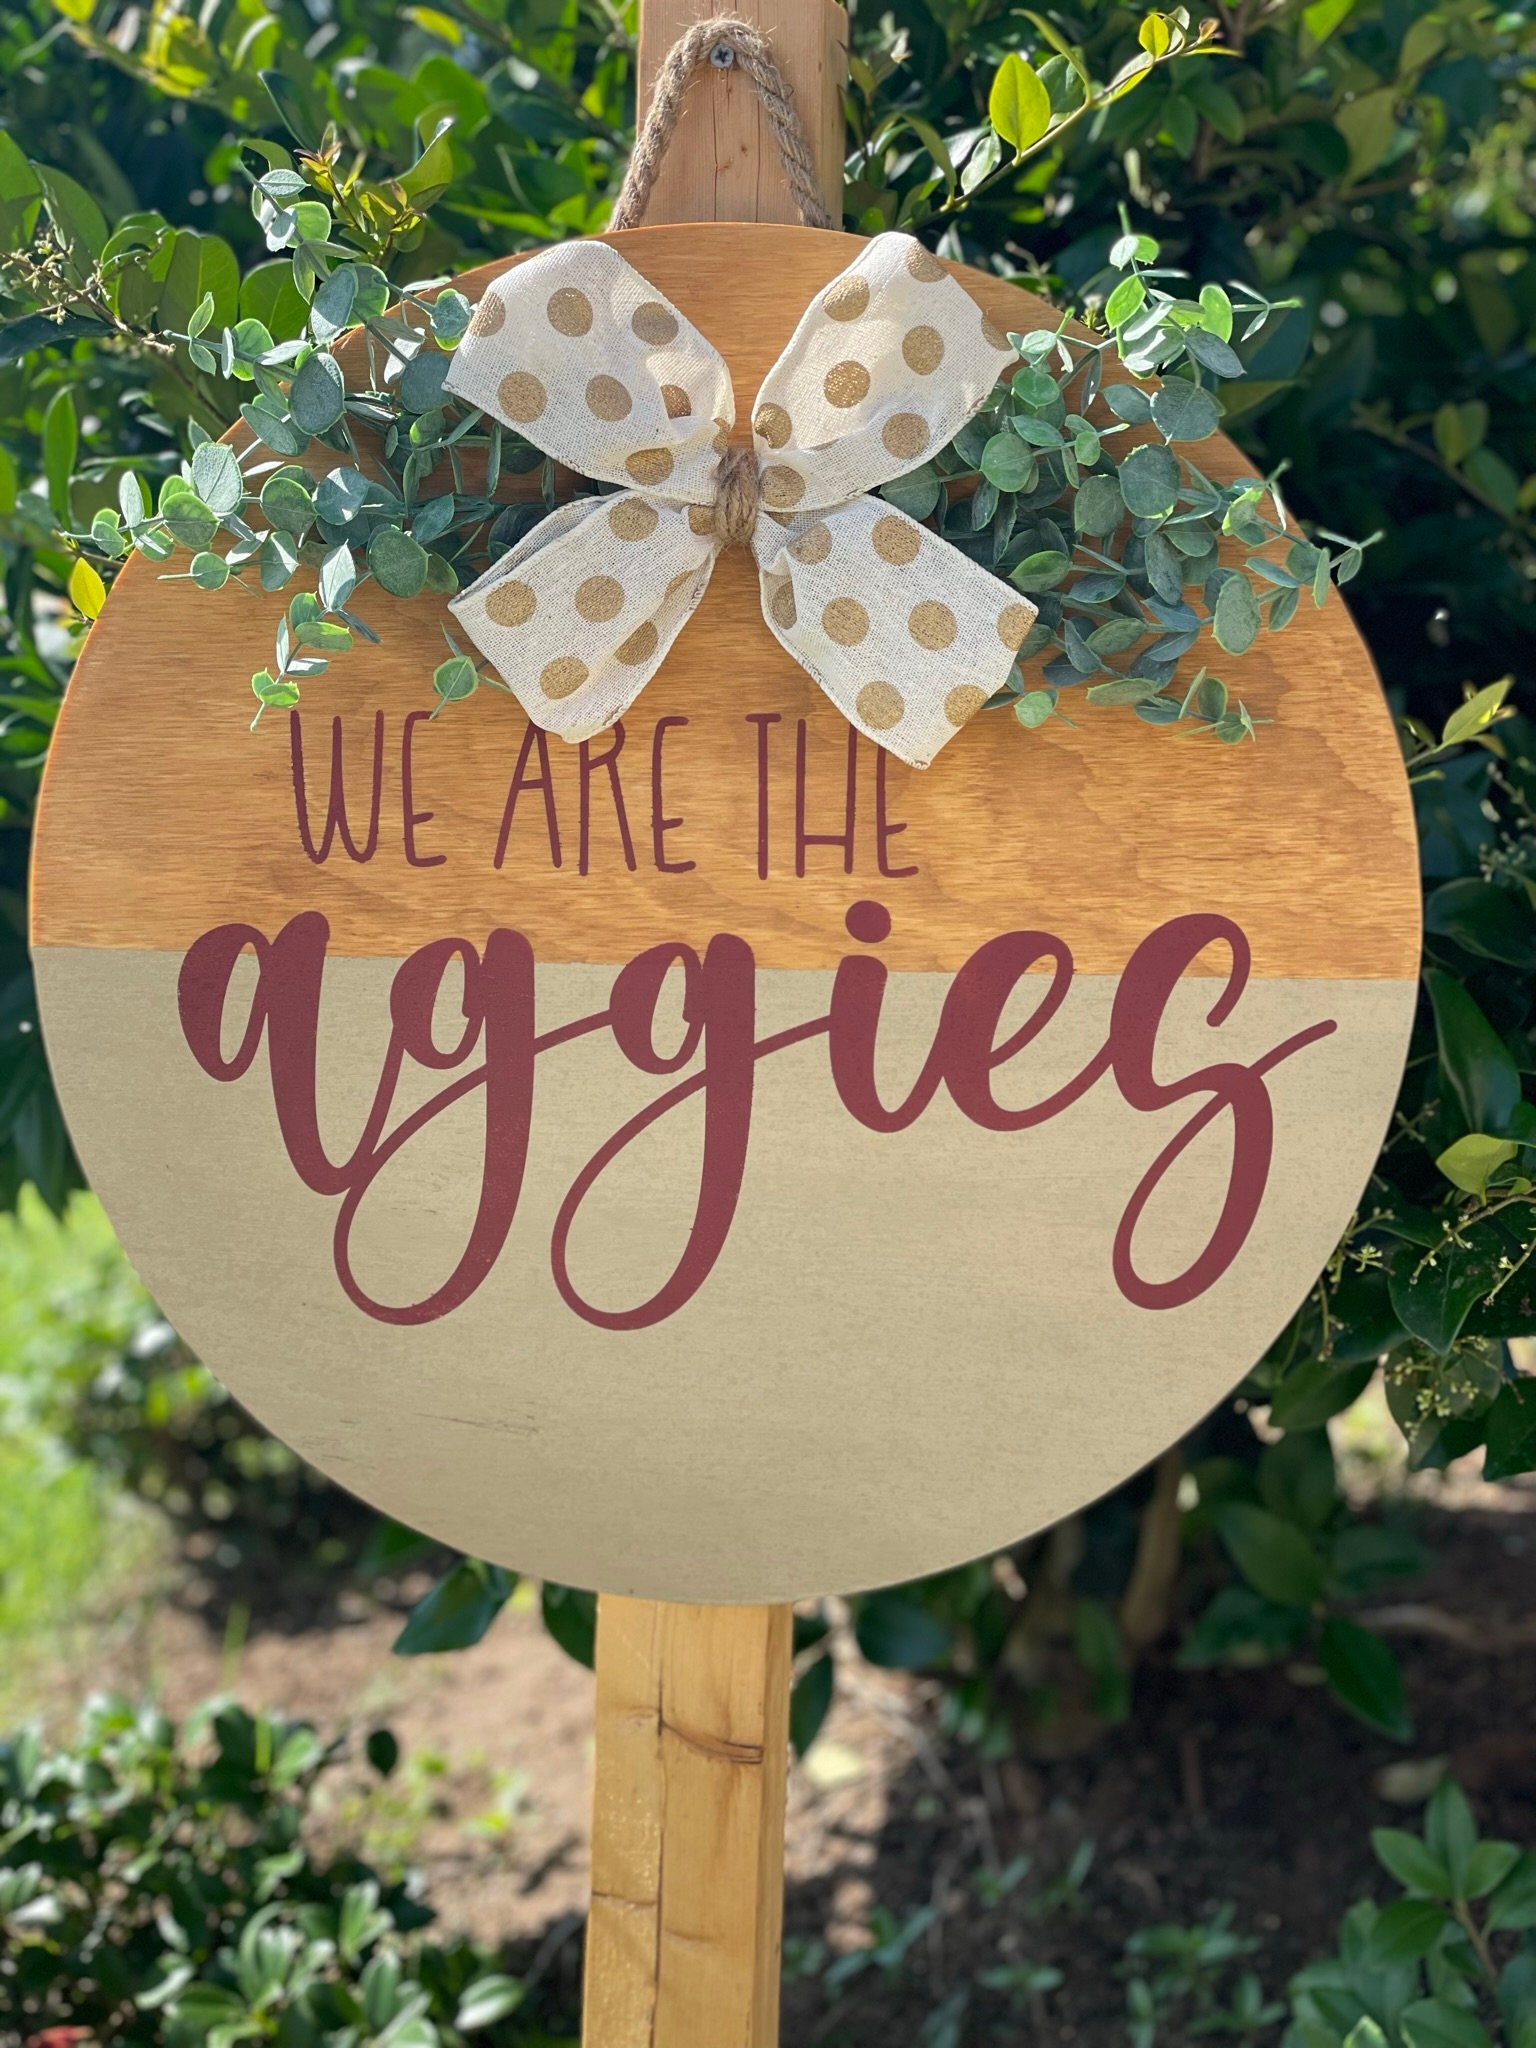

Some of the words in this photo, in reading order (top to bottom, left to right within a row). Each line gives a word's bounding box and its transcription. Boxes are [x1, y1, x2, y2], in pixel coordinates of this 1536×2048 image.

[290, 709, 447, 868] WE
[493, 715, 697, 876] ARE
[745, 712, 919, 880] THE
[178, 900, 1337, 1332] aggies
